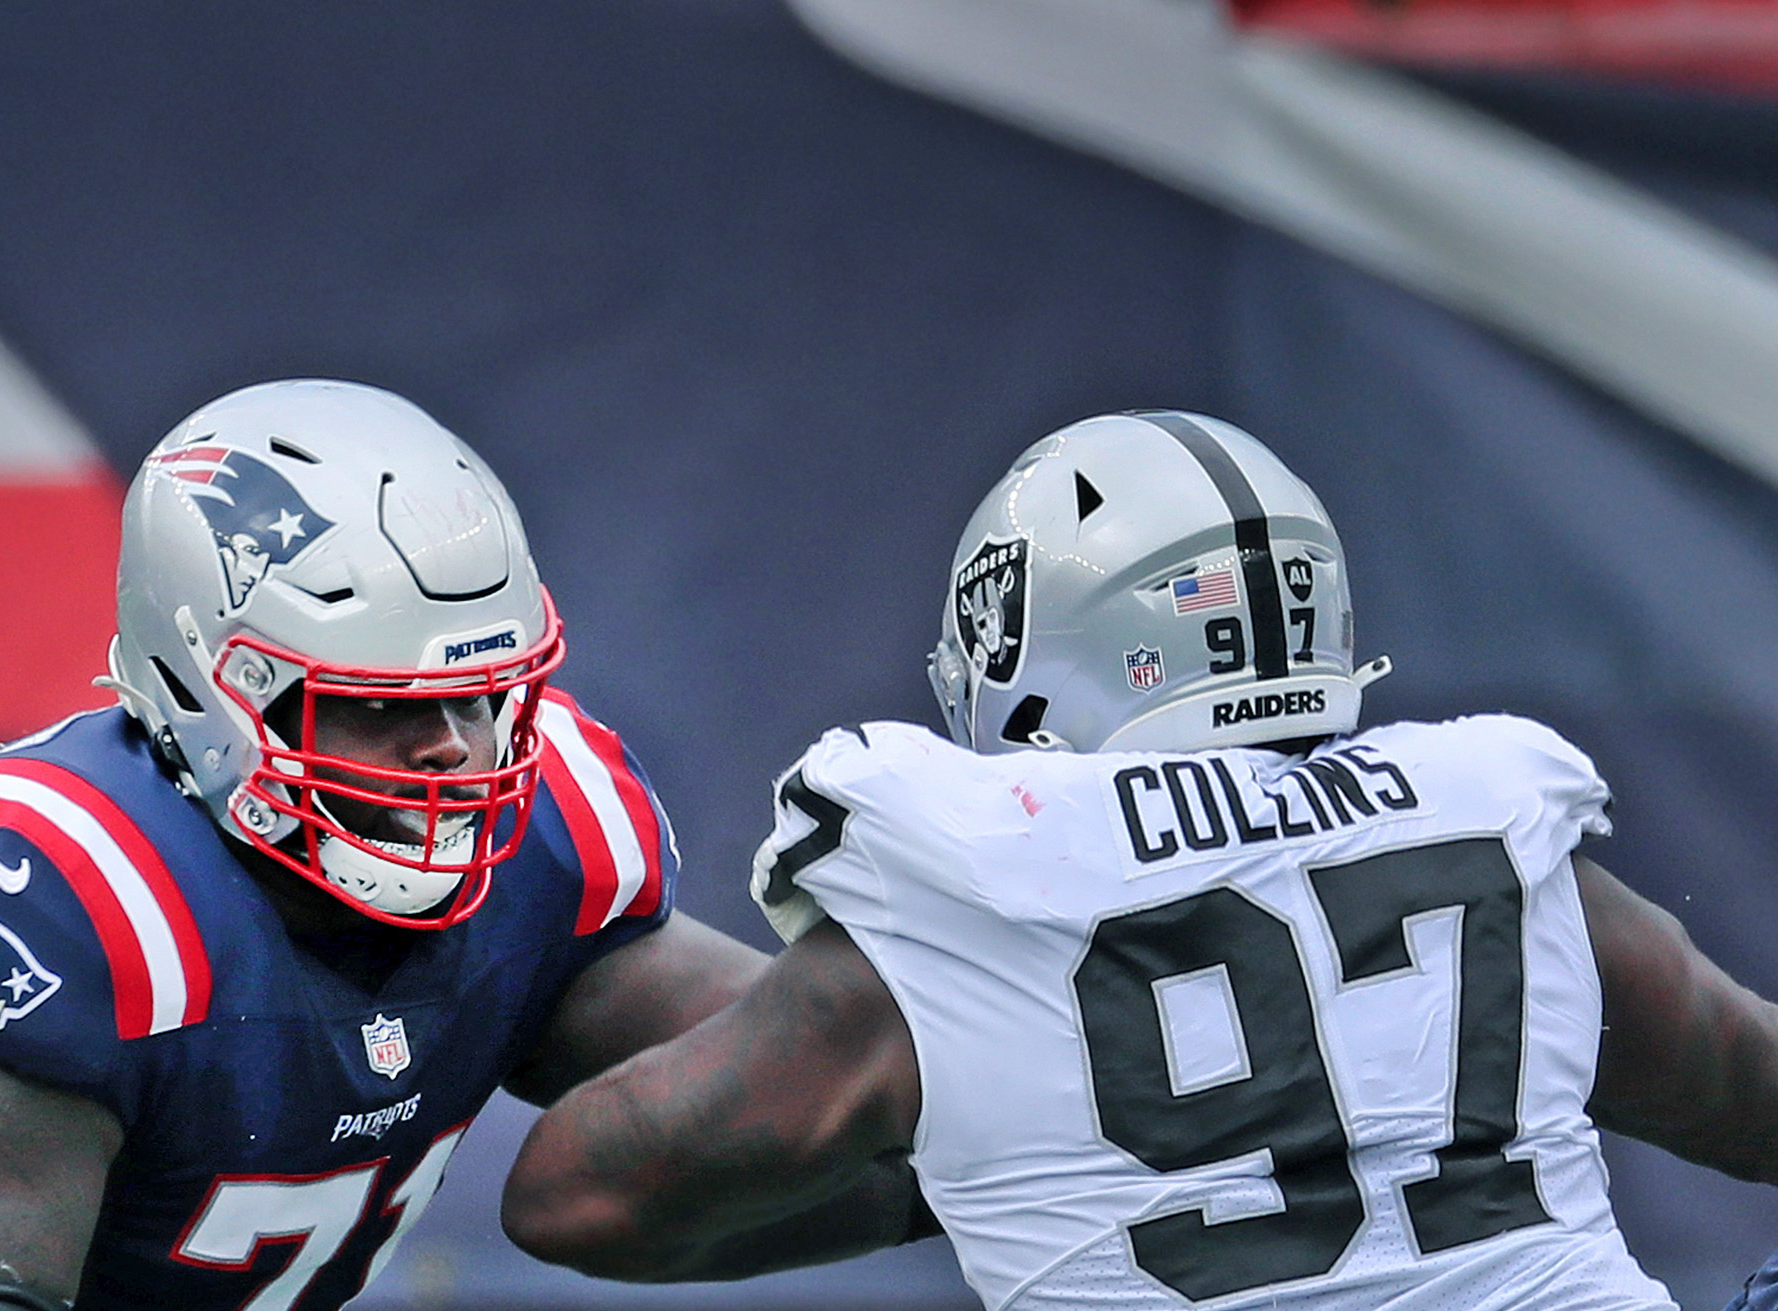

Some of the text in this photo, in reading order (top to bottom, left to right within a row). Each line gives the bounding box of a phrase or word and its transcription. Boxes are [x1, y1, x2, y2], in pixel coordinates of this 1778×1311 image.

[959, 543, 1019, 589] RAIDERS
[1289, 565, 1313, 586] AL
[445, 630, 516, 665] PATRIOTS
[1132, 665, 1162, 686] NFL
[1212, 689, 1326, 728] RAIDERS
[1114, 745, 1420, 864] COLLINS
[374, 1042, 404, 1065] NFL
[1069, 832, 1562, 1308] 97
[330, 1092, 421, 1142] PATRIOTS
